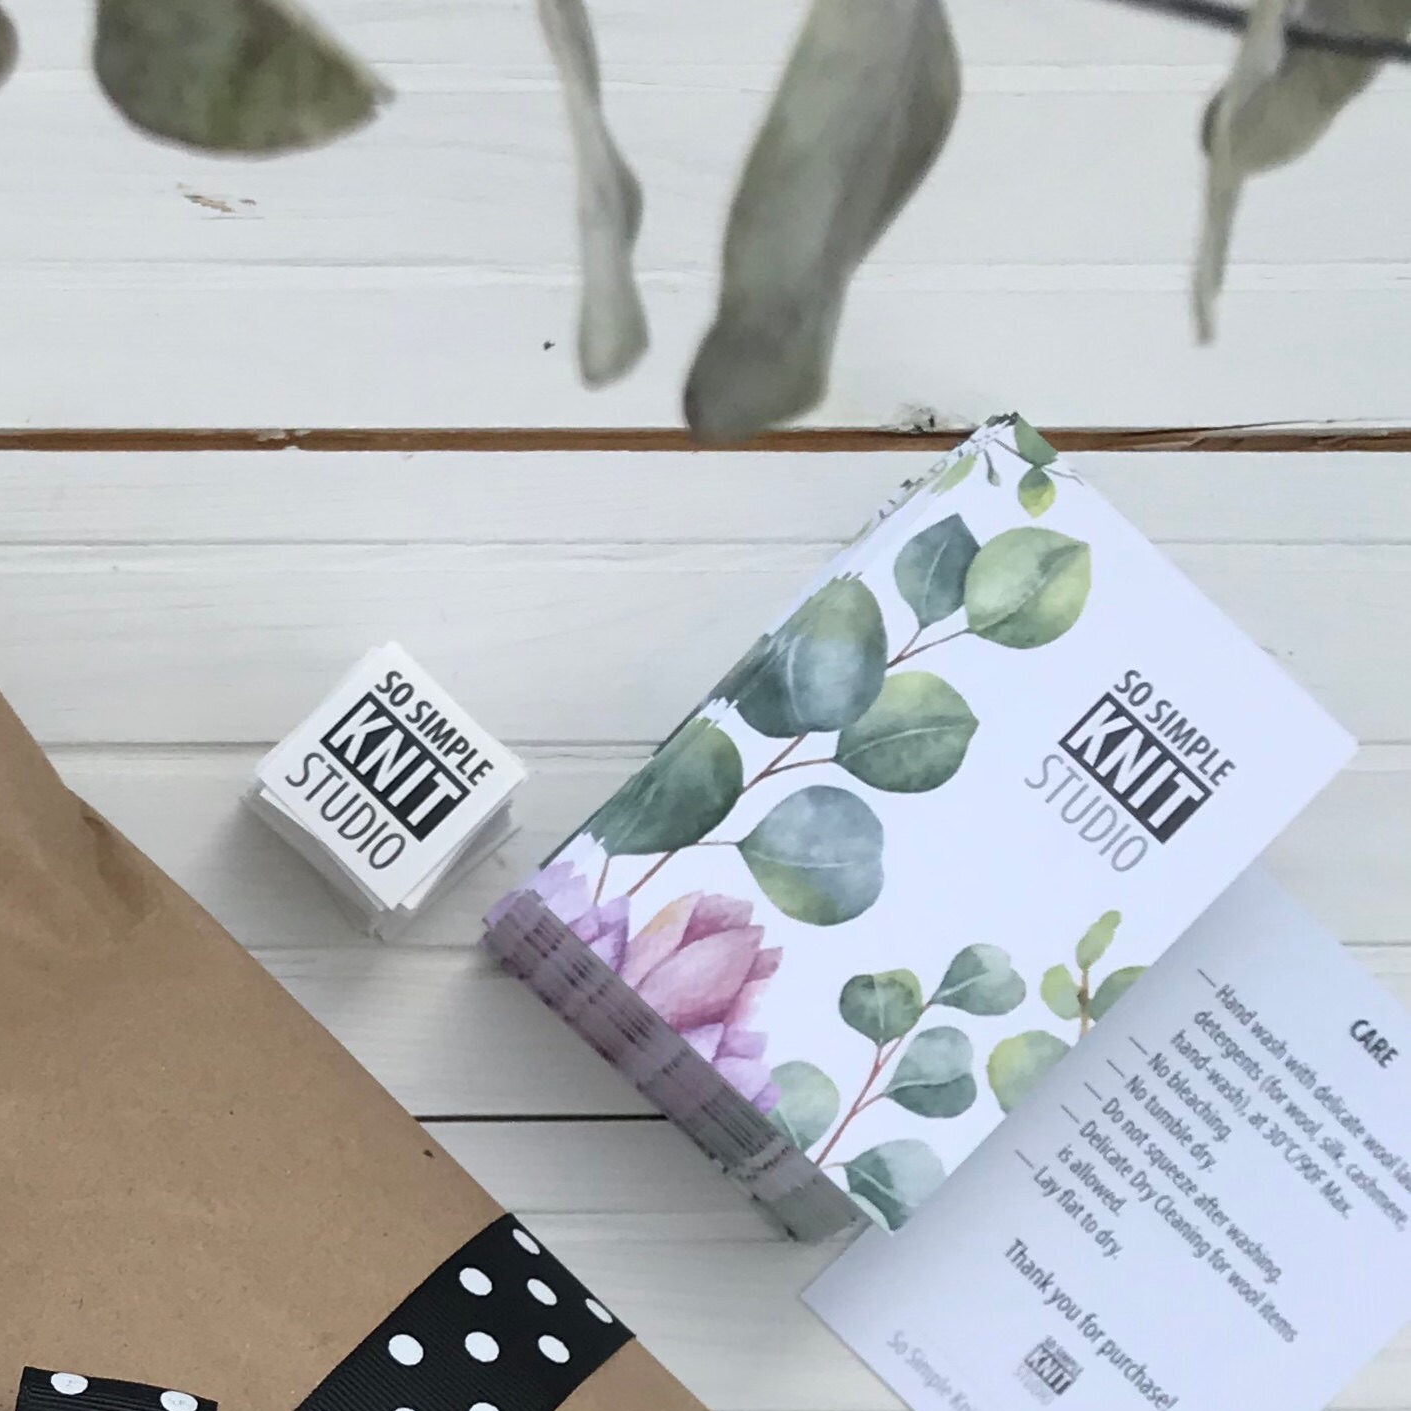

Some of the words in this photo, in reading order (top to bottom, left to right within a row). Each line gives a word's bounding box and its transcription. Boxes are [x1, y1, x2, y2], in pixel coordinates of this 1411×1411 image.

[328, 699, 464, 828] KNIT
[374, 670, 415, 708] SO
[405, 700, 494, 787] SIMPLE
[1065, 700, 1206, 830] KNIT
[1113, 669, 1154, 707] SO
[1144, 699, 1237, 787] SIMPLE
[285, 752, 406, 871] STUDIO
[1024, 754, 1149, 873] STUDIO
[1147, 1053, 1170, 1078] No
[1167, 1071, 1232, 1142] bleaching.
[1194, 1011, 1263, 1081] detergents
[1259, 1075, 1288, 1104] (for
[1284, 1102, 1323, 1142] wool,
[1215, 984, 1258, 1026] Hand
[1250, 1022, 1287, 1060] wash
[1284, 1055, 1317, 1089] with
[1313, 1086, 1365, 1138] delicate
[1362, 1134, 1401, 1170] wool
[1350, 1020, 1398, 1068] CARE
[1125, 1075, 1147, 1101] No
[1144, 1095, 1193, 1147] tumble
[1190, 1143, 1216, 1172] dry.
[1248, 1112, 1269, 1130] at
[1034, 1166, 1061, 1197] Lay
[1057, 1189, 1084, 1219] flat
[1080, 1212, 1098, 1233] to
[1095, 1230, 1122, 1260] dry.
[1057, 1144, 1073, 1163] is
[1069, 1160, 1127, 1217] allowed.
[1080, 1120, 1133, 1178] Delicate
[1129, 1170, 1158, 1202] Dry
[1154, 1195, 1211, 1258] Cleaning
[1208, 1248, 1231, 1274] for
[1228, 1271, 1266, 1307] wool
[1258, 1301, 1298, 1342] items
[1102, 1097, 1124, 1123] Do
[1121, 1120, 1150, 1147] not
[1144, 1143, 1198, 1197] squeeze
[1194, 1194, 1229, 1226] after
[1226, 1224, 1281, 1285] washing.
[1005, 1238, 1054, 1294] Thank
[1043, 1287, 1082, 1321] you
[1077, 1313, 1105, 1343] for
[887, 1331, 908, 1355] So
[905, 1348, 952, 1395] Simple
[1026, 1344, 1074, 1395] KNIT
